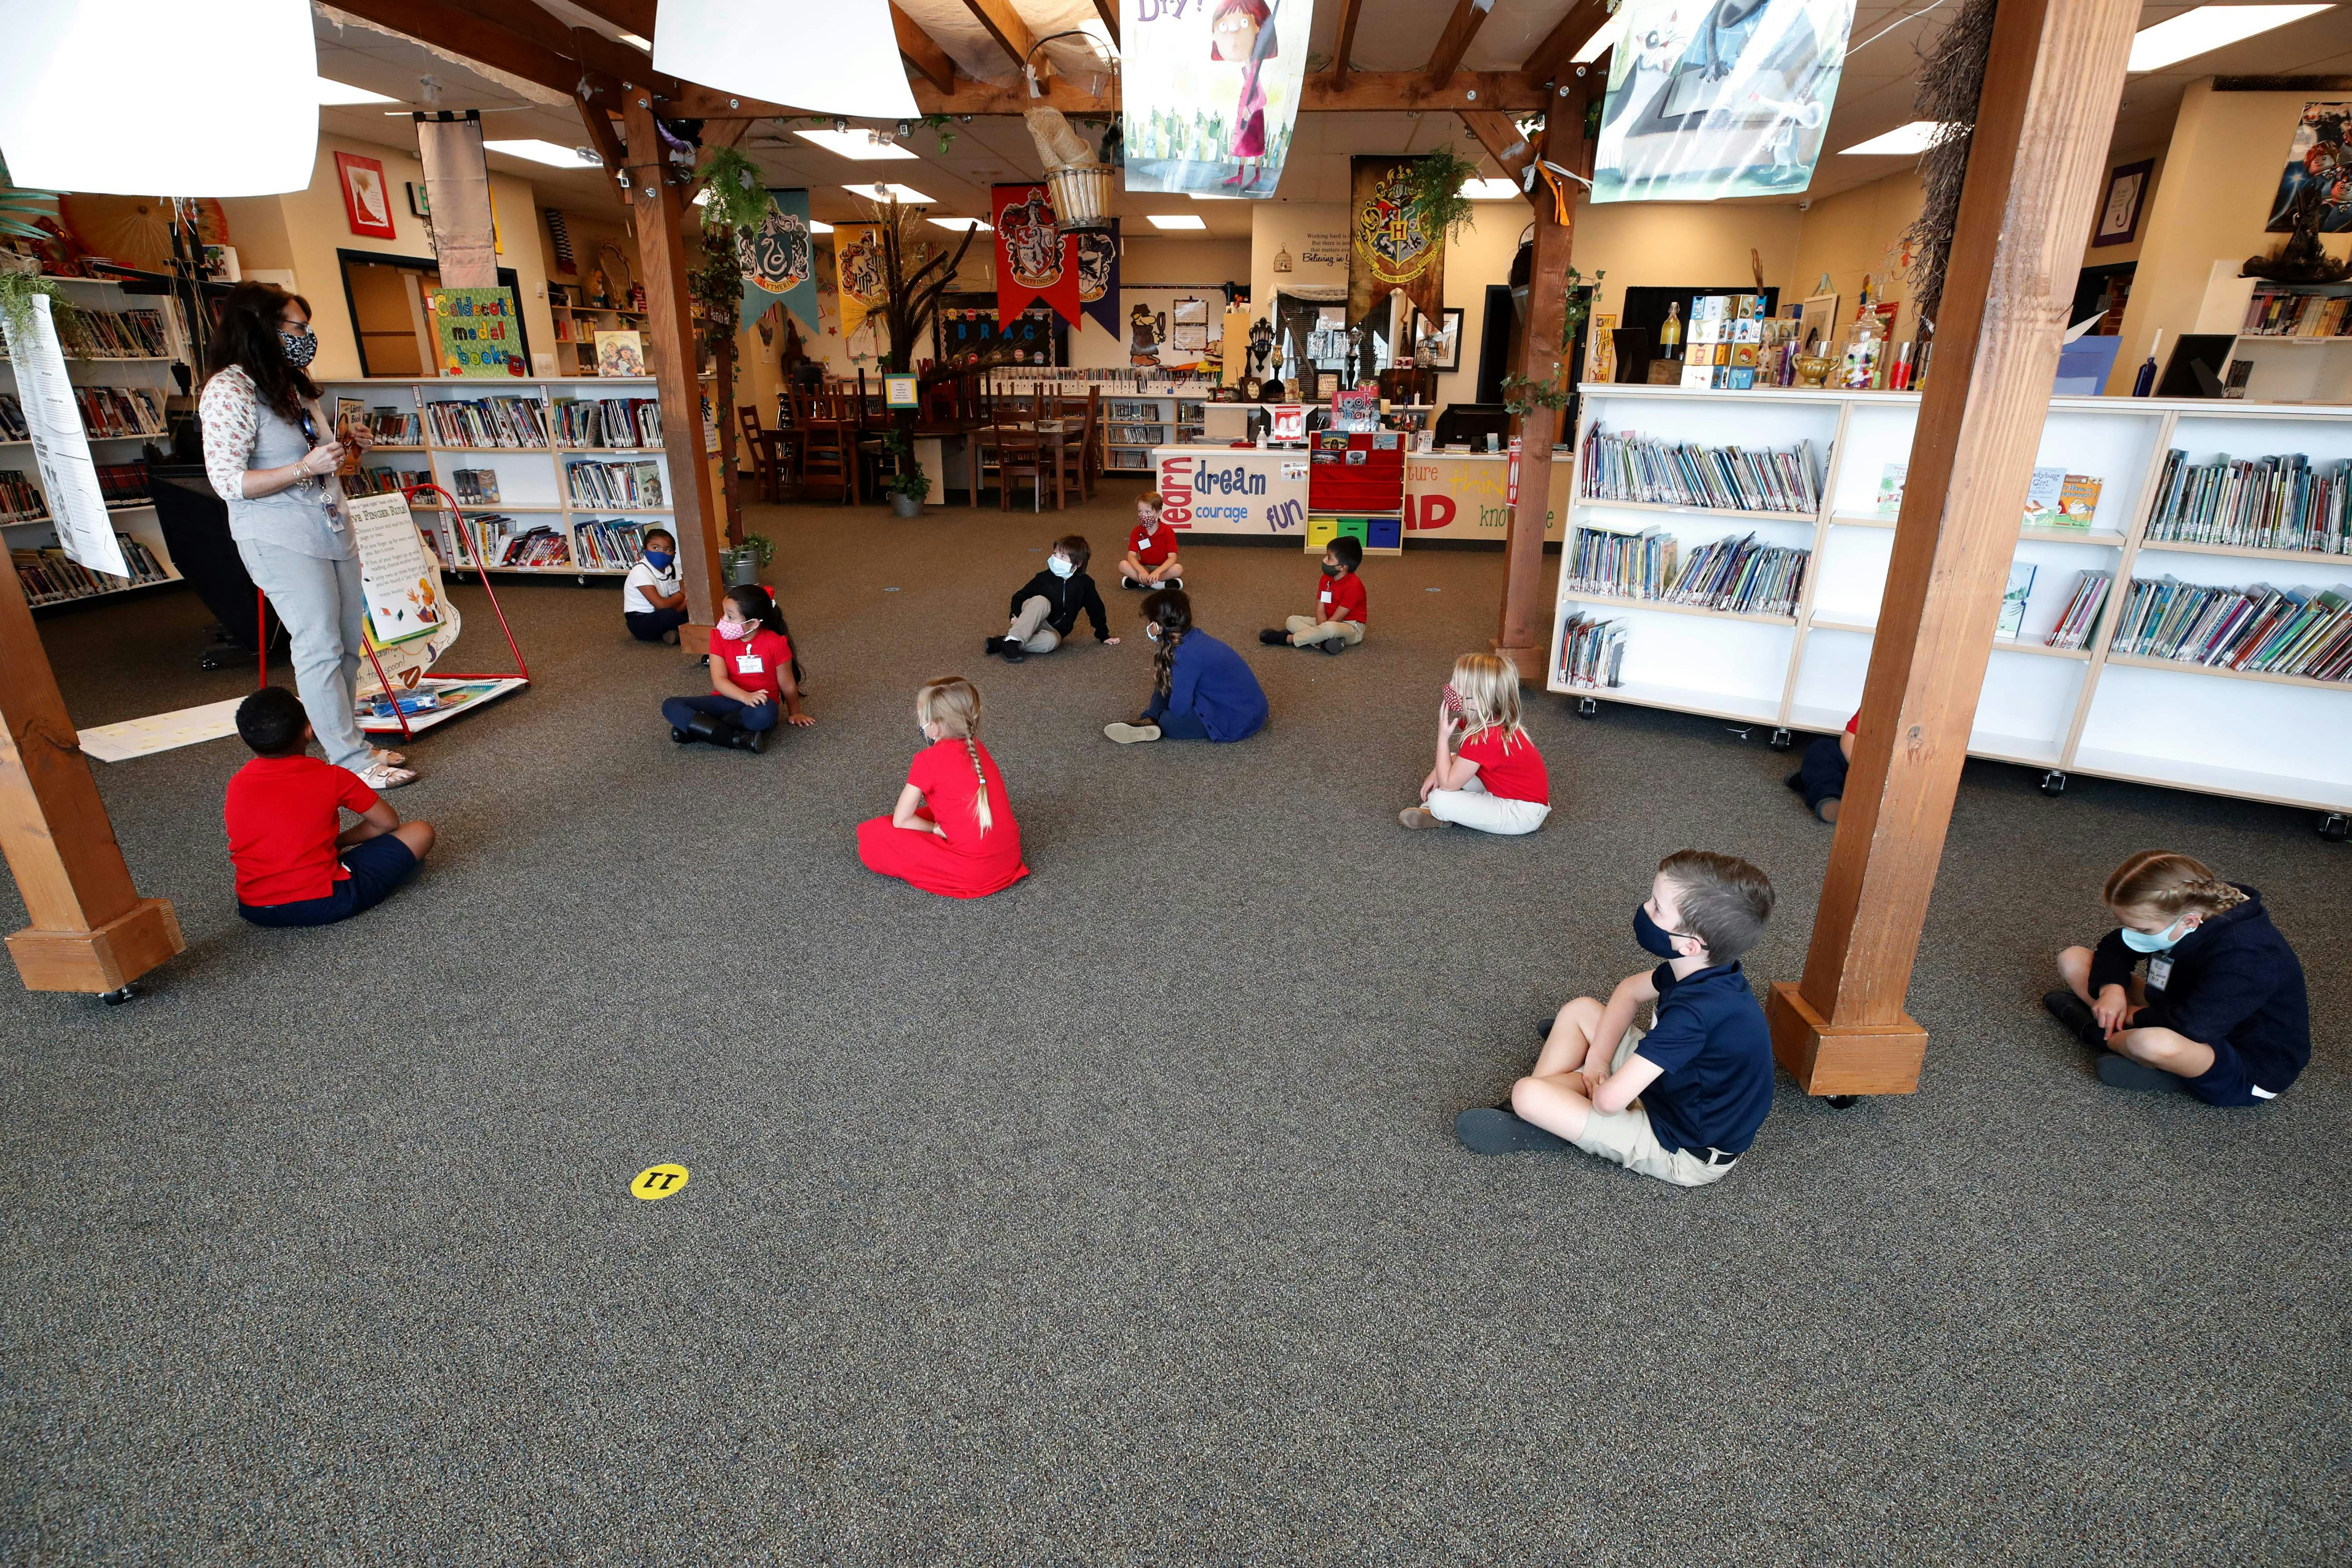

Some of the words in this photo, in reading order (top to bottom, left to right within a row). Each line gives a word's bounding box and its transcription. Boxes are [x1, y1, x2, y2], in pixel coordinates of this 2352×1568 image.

[1302, 253, 1335, 266] Believing
[1361, 251, 1375, 266] DRACO
[1018, 275, 1055, 285] GRYFFINDOR
[1374, 269, 1397, 282] DORMIENS
[1398, 269, 1421, 282] NUNQUAM
[758, 278, 794, 291] SLYTHERIN
[1080, 291, 1101, 301] ENCLAW
[434, 294, 516, 317] Caldecott
[452, 321, 505, 341] medal
[456, 345, 509, 365] books
[1592, 370, 1606, 381] YOU
[1337, 393, 1372, 408] look
[1332, 407, 1381, 421] what's
[1194, 460, 1266, 495] dream
[1407, 466, 1438, 481] ture
[2032, 471, 2060, 481] adybug
[1161, 457, 1192, 529] learn
[362, 509, 390, 521] FINGER
[1196, 506, 1248, 523] courage
[1266, 499, 1304, 532] fun
[384, 654, 406, 677] spoon!
